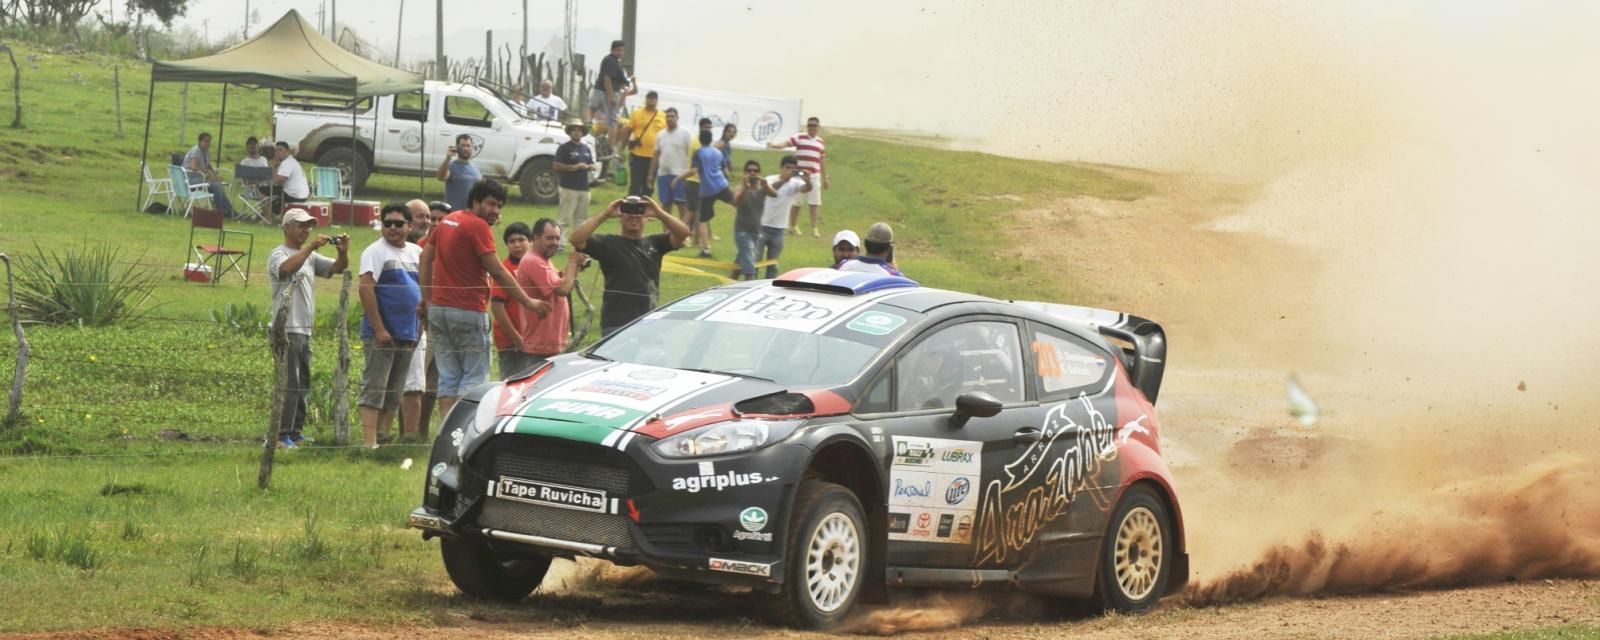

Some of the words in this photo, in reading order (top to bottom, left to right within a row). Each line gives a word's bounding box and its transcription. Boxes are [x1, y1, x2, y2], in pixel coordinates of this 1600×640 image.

[941, 450, 974, 464] LUBRAX
[1022, 419, 1060, 474] ARROZ
[503, 480, 537, 497] Tape
[540, 486, 601, 507] Ruvicha
[672, 470, 763, 493] agriplus
